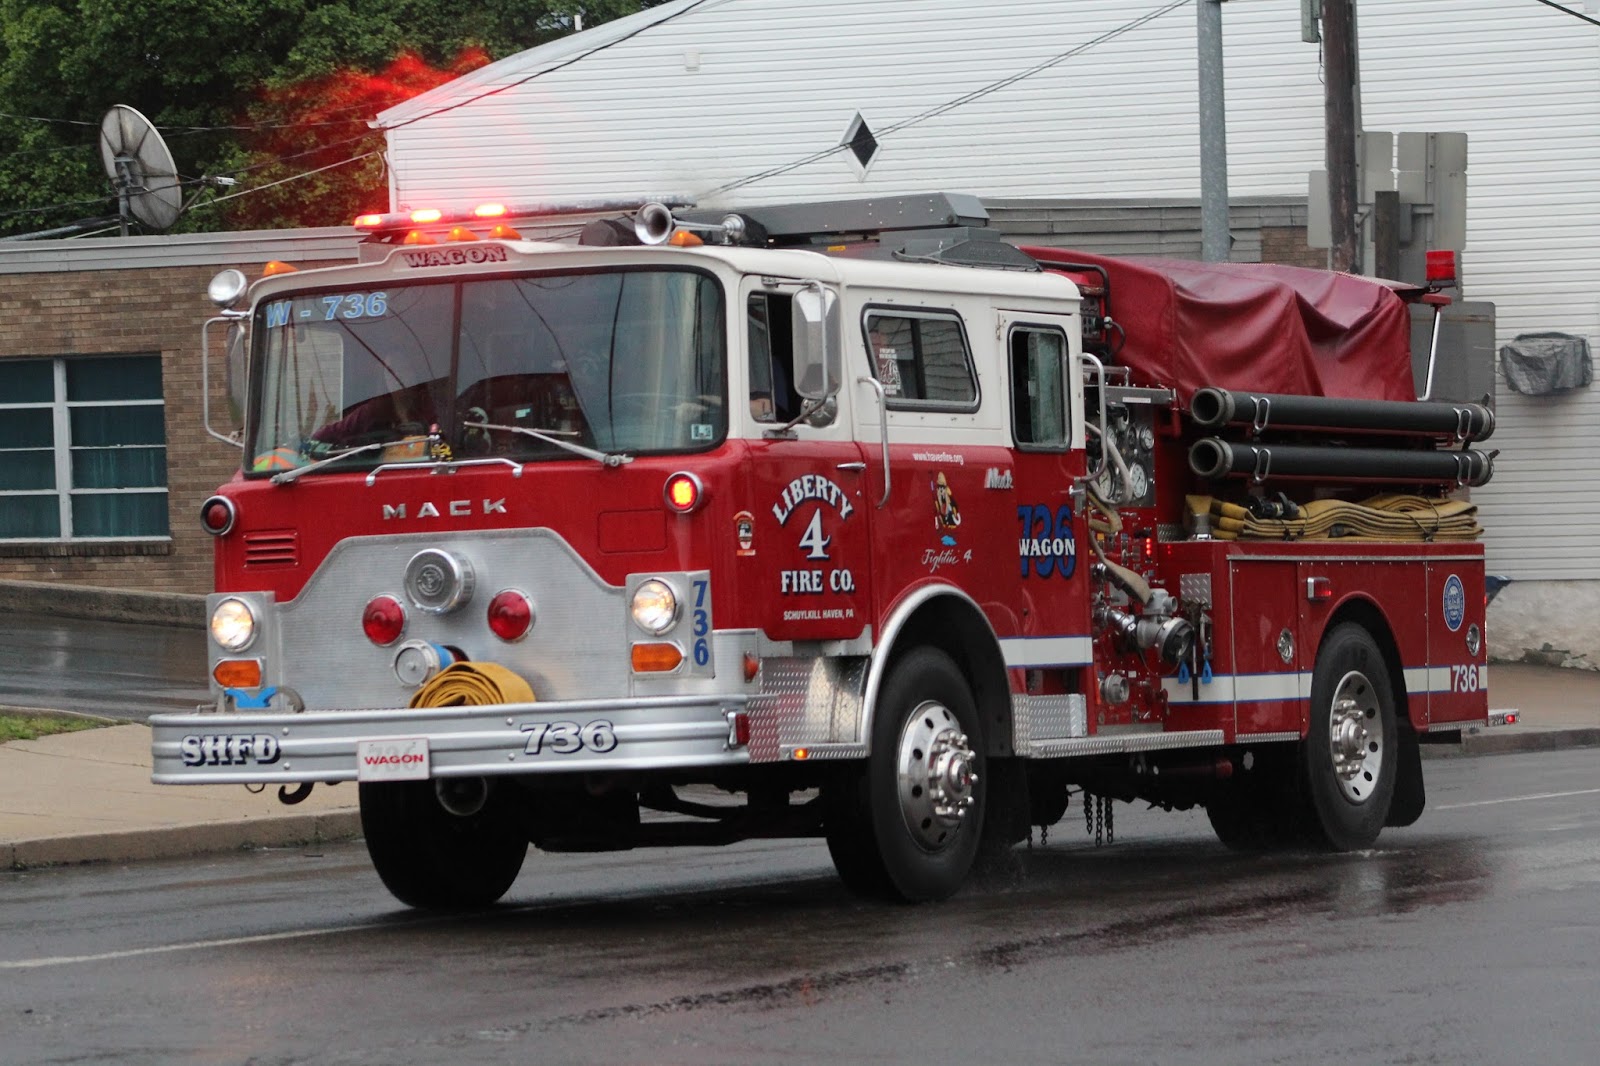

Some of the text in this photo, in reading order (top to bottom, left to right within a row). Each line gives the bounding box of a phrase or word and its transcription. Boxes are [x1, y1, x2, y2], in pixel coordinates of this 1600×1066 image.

[402, 248, 508, 268] WAGON
[265, 301, 292, 328] W
[322, 291, 388, 321] 736
[382, 497, 508, 520] MACK
[772, 474, 854, 526] LIBERTY
[799, 507, 831, 561] 4
[1016, 503, 1077, 580] 736
[1018, 538, 1076, 557] WAGON
[781, 568, 856, 594] FIRE CO.
[783, 608, 854, 621] SCHUYLKILL HAVEN, PA
[1452, 663, 1478, 693] 736
[180, 733, 281, 767] SHFD
[519, 718, 618, 756] 736
[364, 754, 424, 766] WAGON
